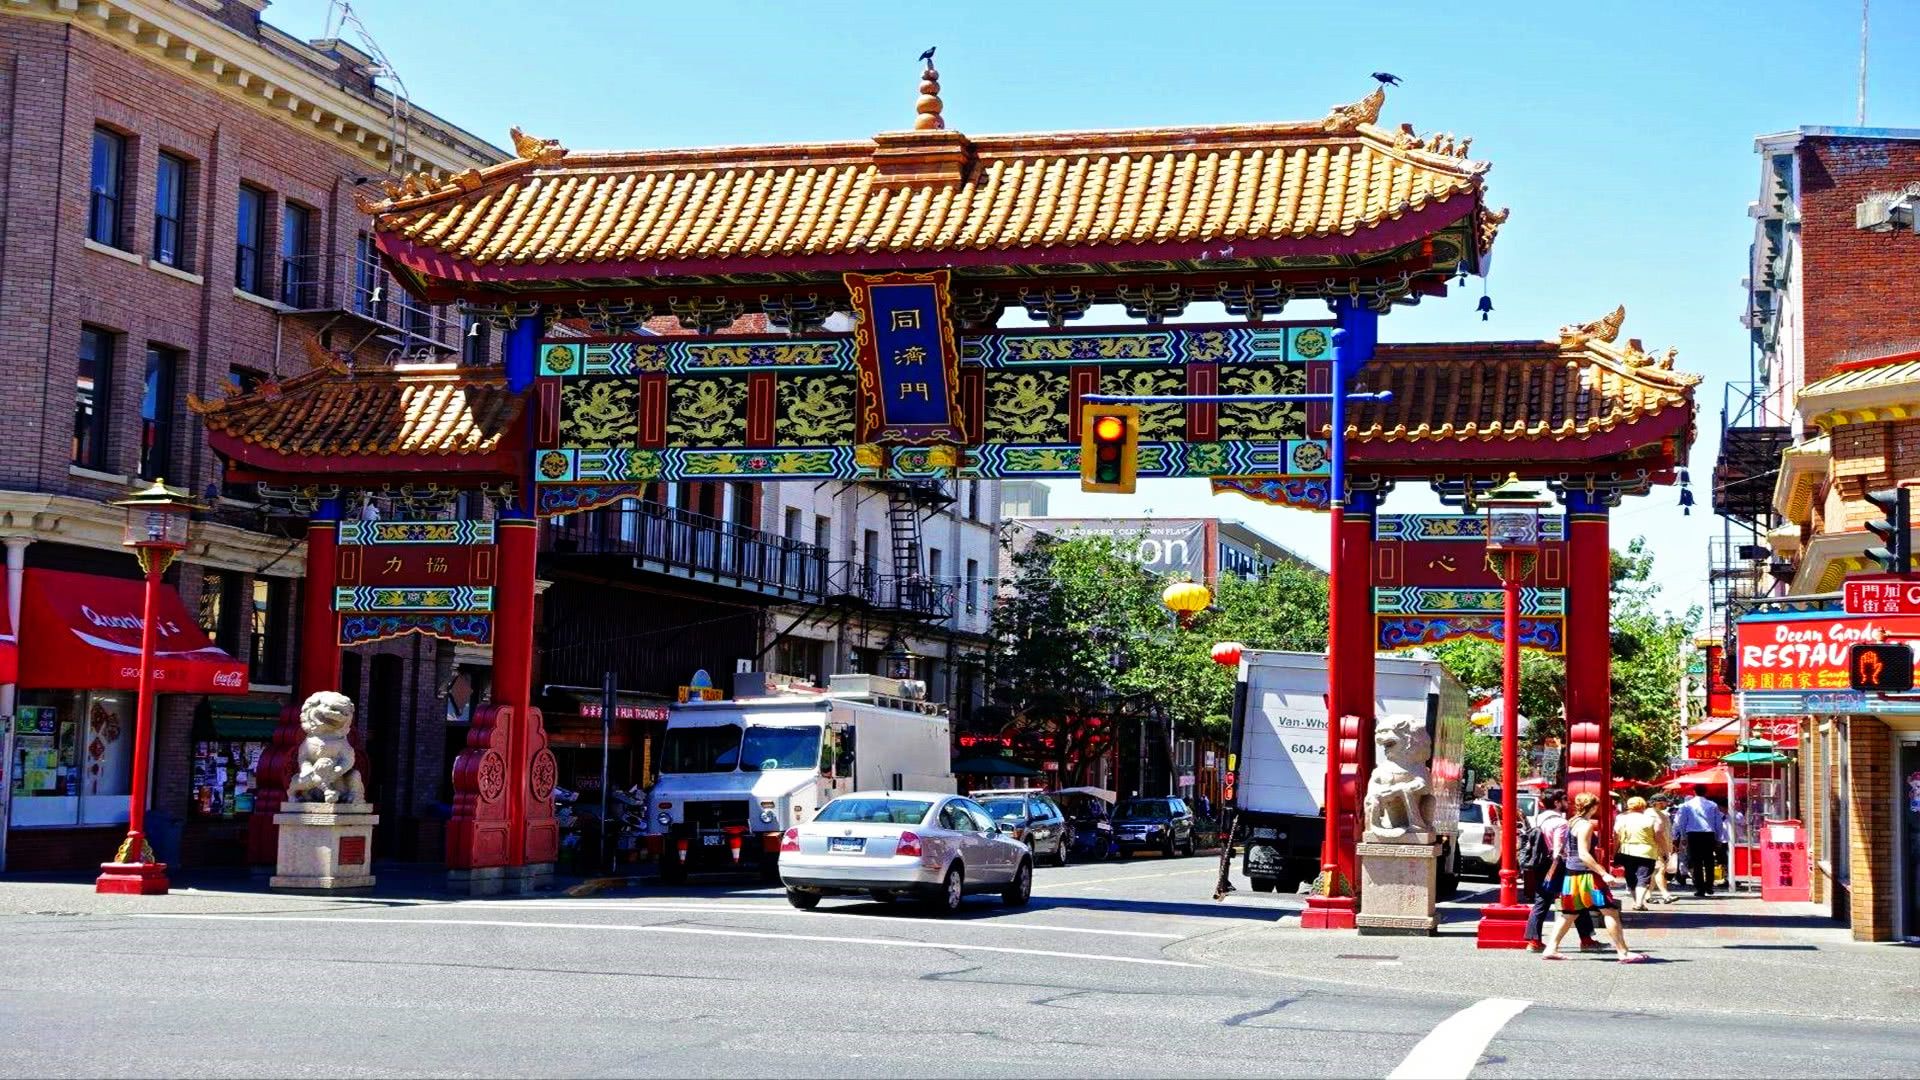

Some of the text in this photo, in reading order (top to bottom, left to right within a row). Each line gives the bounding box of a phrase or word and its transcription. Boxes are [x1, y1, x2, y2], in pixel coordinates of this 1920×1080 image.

[1775, 622, 1881, 643] Ocean Garde
[1291, 744, 1329, 755] 604-2
